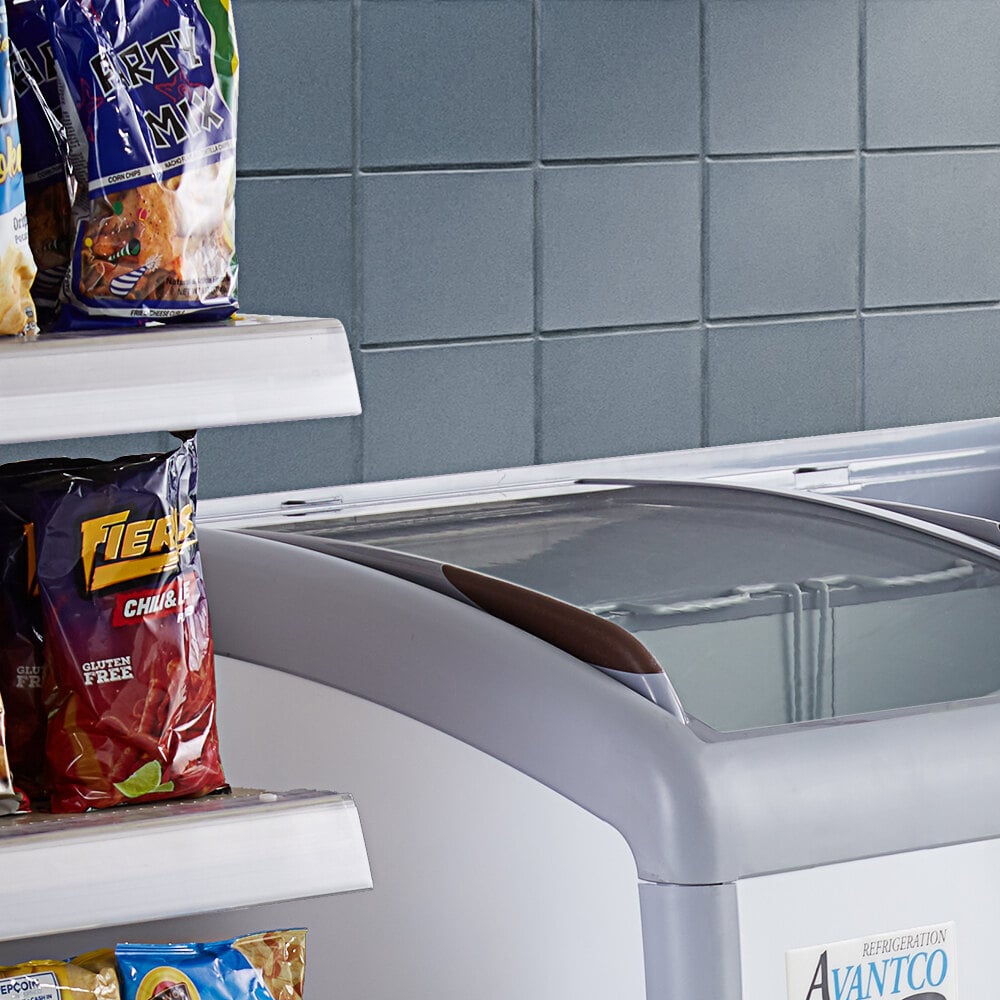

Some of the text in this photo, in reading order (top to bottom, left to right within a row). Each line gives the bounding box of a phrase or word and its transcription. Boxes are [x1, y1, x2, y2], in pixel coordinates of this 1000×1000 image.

[143, 89, 223, 149] MIX
[125, 169, 141, 179] CHIPS
[82, 656, 131, 672] GLUTEN
[84, 665, 134, 686] FREE
[862, 928, 948, 958] REFRIGERATION
[0, 979, 40, 994] EPCOIN
